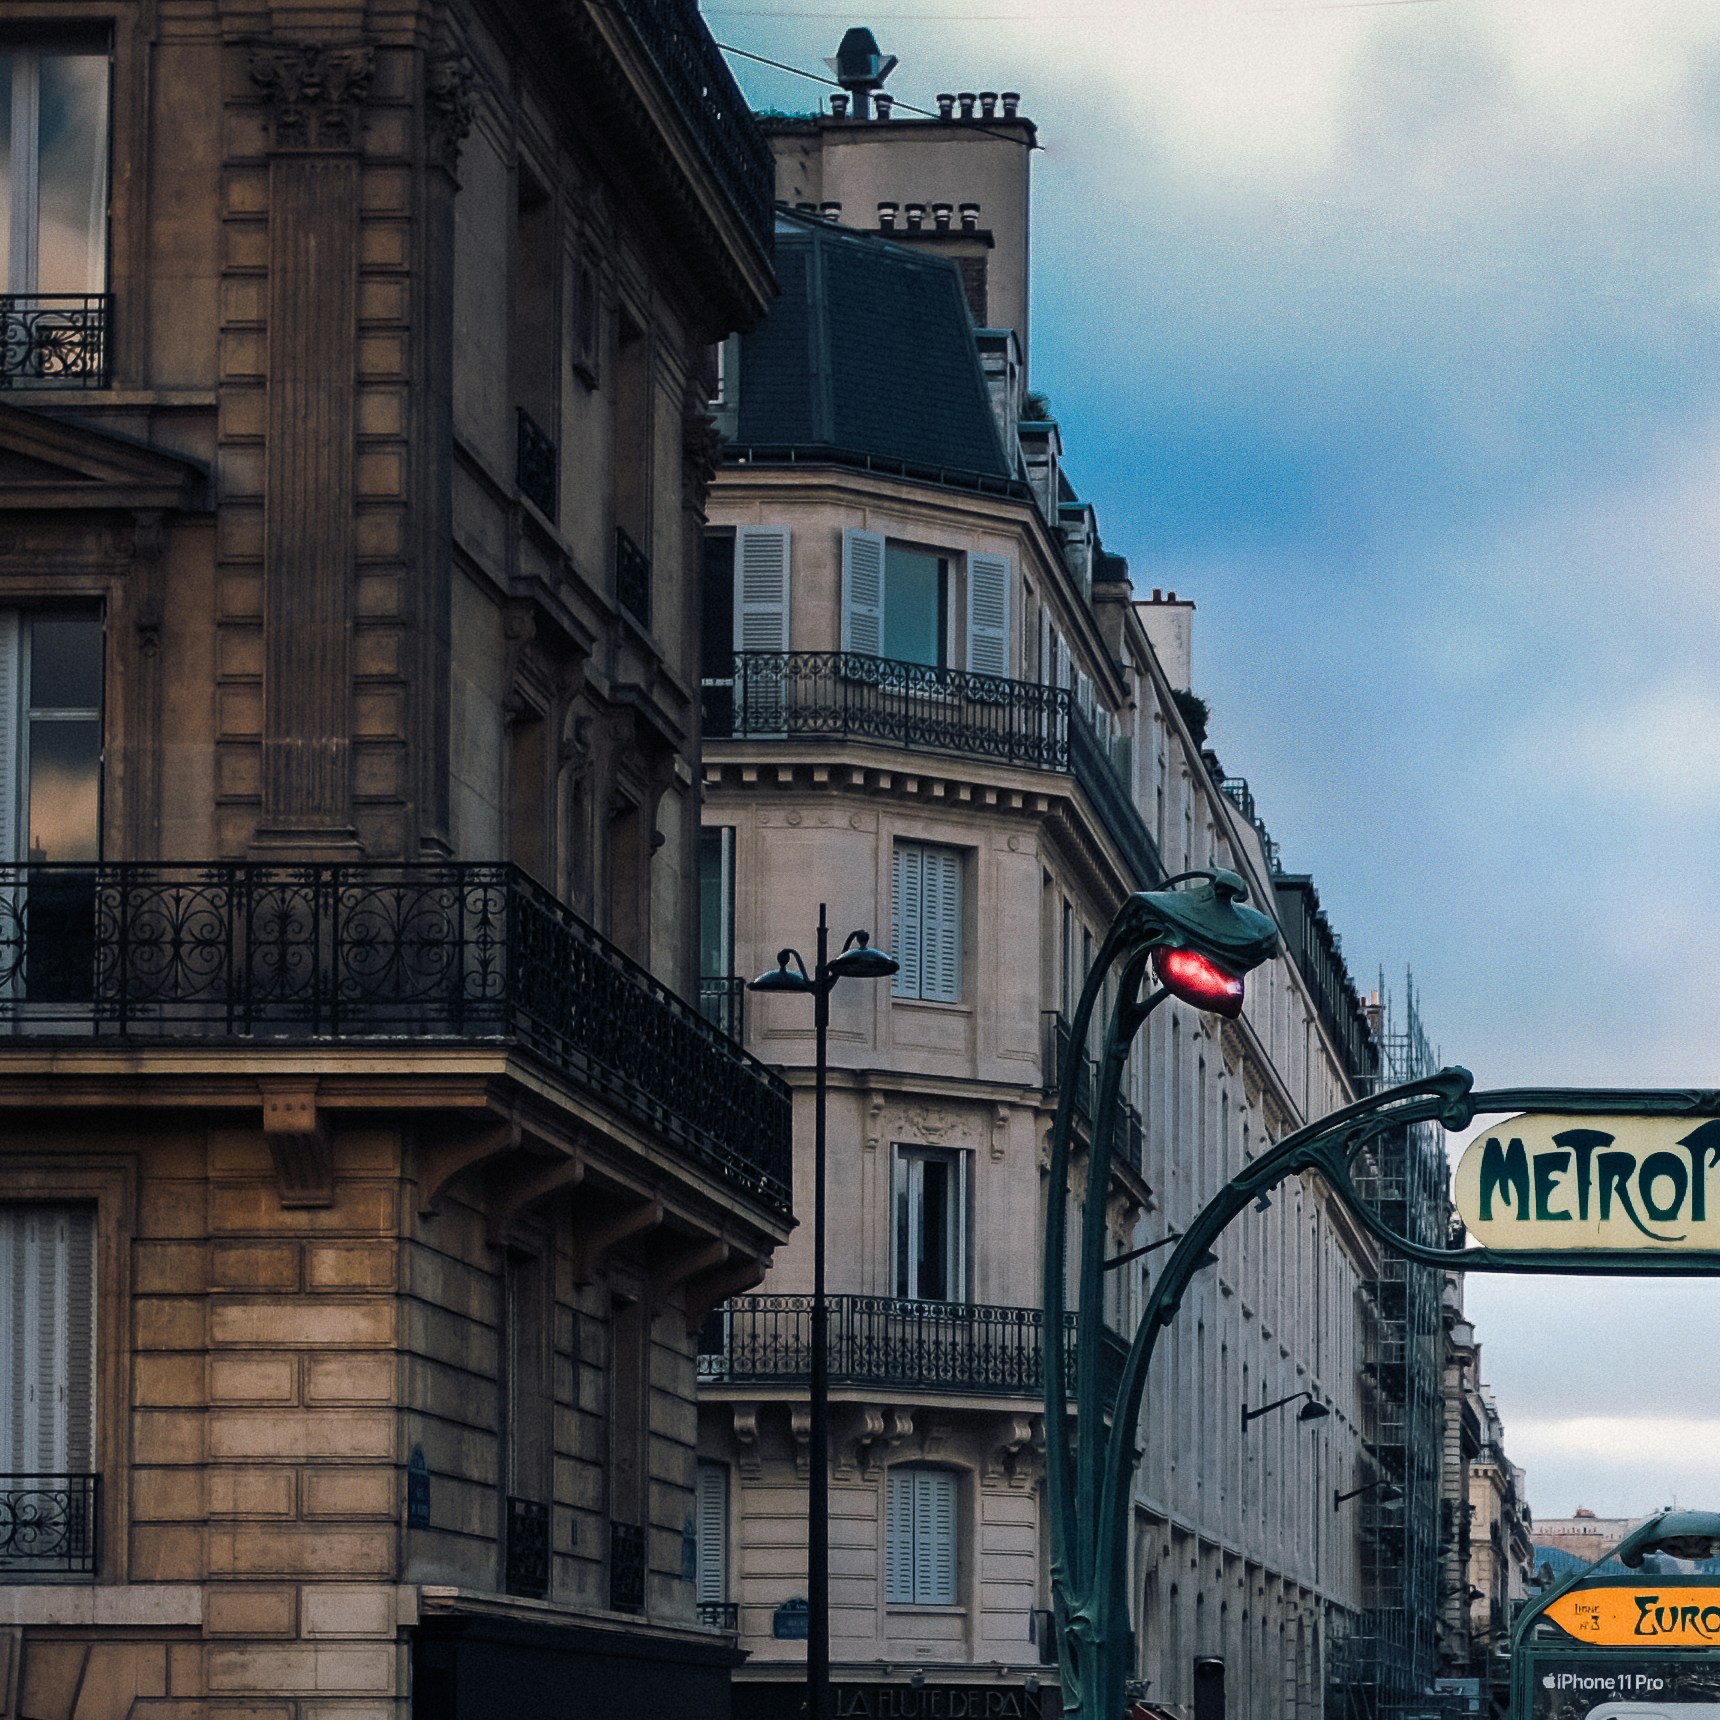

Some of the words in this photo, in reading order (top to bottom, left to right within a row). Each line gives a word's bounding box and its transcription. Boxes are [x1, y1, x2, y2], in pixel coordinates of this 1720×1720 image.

[1557, 1673, 1616, 1690] iPhone
[1617, 1674, 1632, 1690] 11
[1635, 1674, 1664, 1690] Pro
[834, 1689, 871, 1717] LA
[878, 1689, 942, 1718] FLUTE
[949, 1690, 979, 1718] DE
